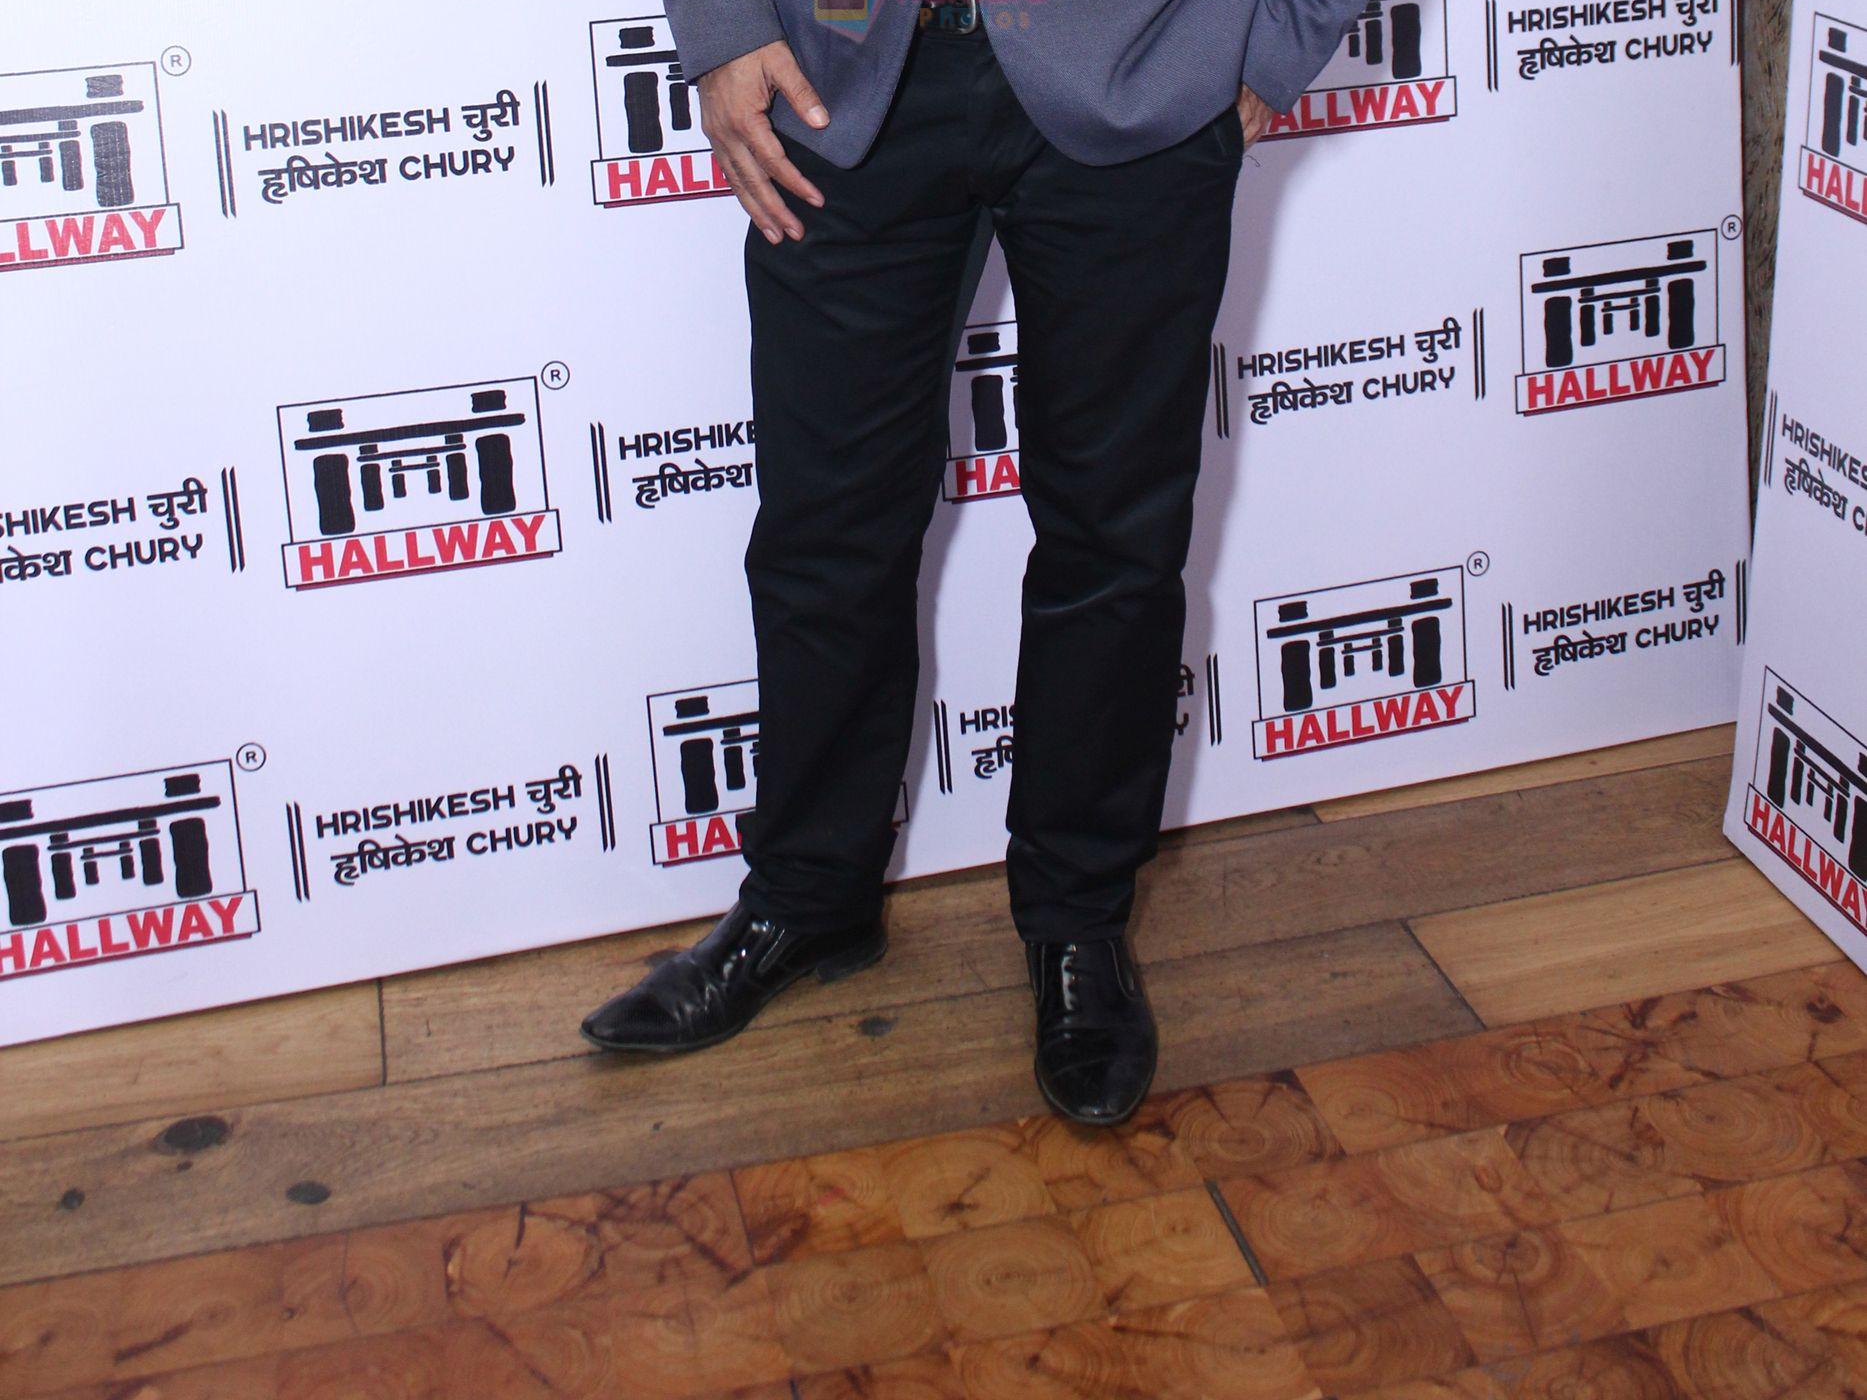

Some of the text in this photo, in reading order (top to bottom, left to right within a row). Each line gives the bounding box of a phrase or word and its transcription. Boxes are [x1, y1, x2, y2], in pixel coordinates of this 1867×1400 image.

[1625, 31, 1712, 60] CHURY
[244, 90, 520, 151] HRISHIKESH चुरी
[399, 146, 514, 180] CHURY
[1238, 317, 1462, 378] HRISHIKESH चुरी
[1363, 367, 1455, 400] CHURY
[1526, 346, 1715, 410] HALLWAY
[147, 478, 207, 530] चुरी
[85, 534, 203, 571] CHURY
[298, 515, 546, 582] HALLWAY
[1524, 569, 1725, 634] HRISHIKESH चुरी
[1635, 615, 1719, 648] CHURY
[1265, 686, 1464, 756] HALLWAY
[316, 765, 582, 839] HRISHIKESH चुरी
[467, 816, 577, 855] CHURY
